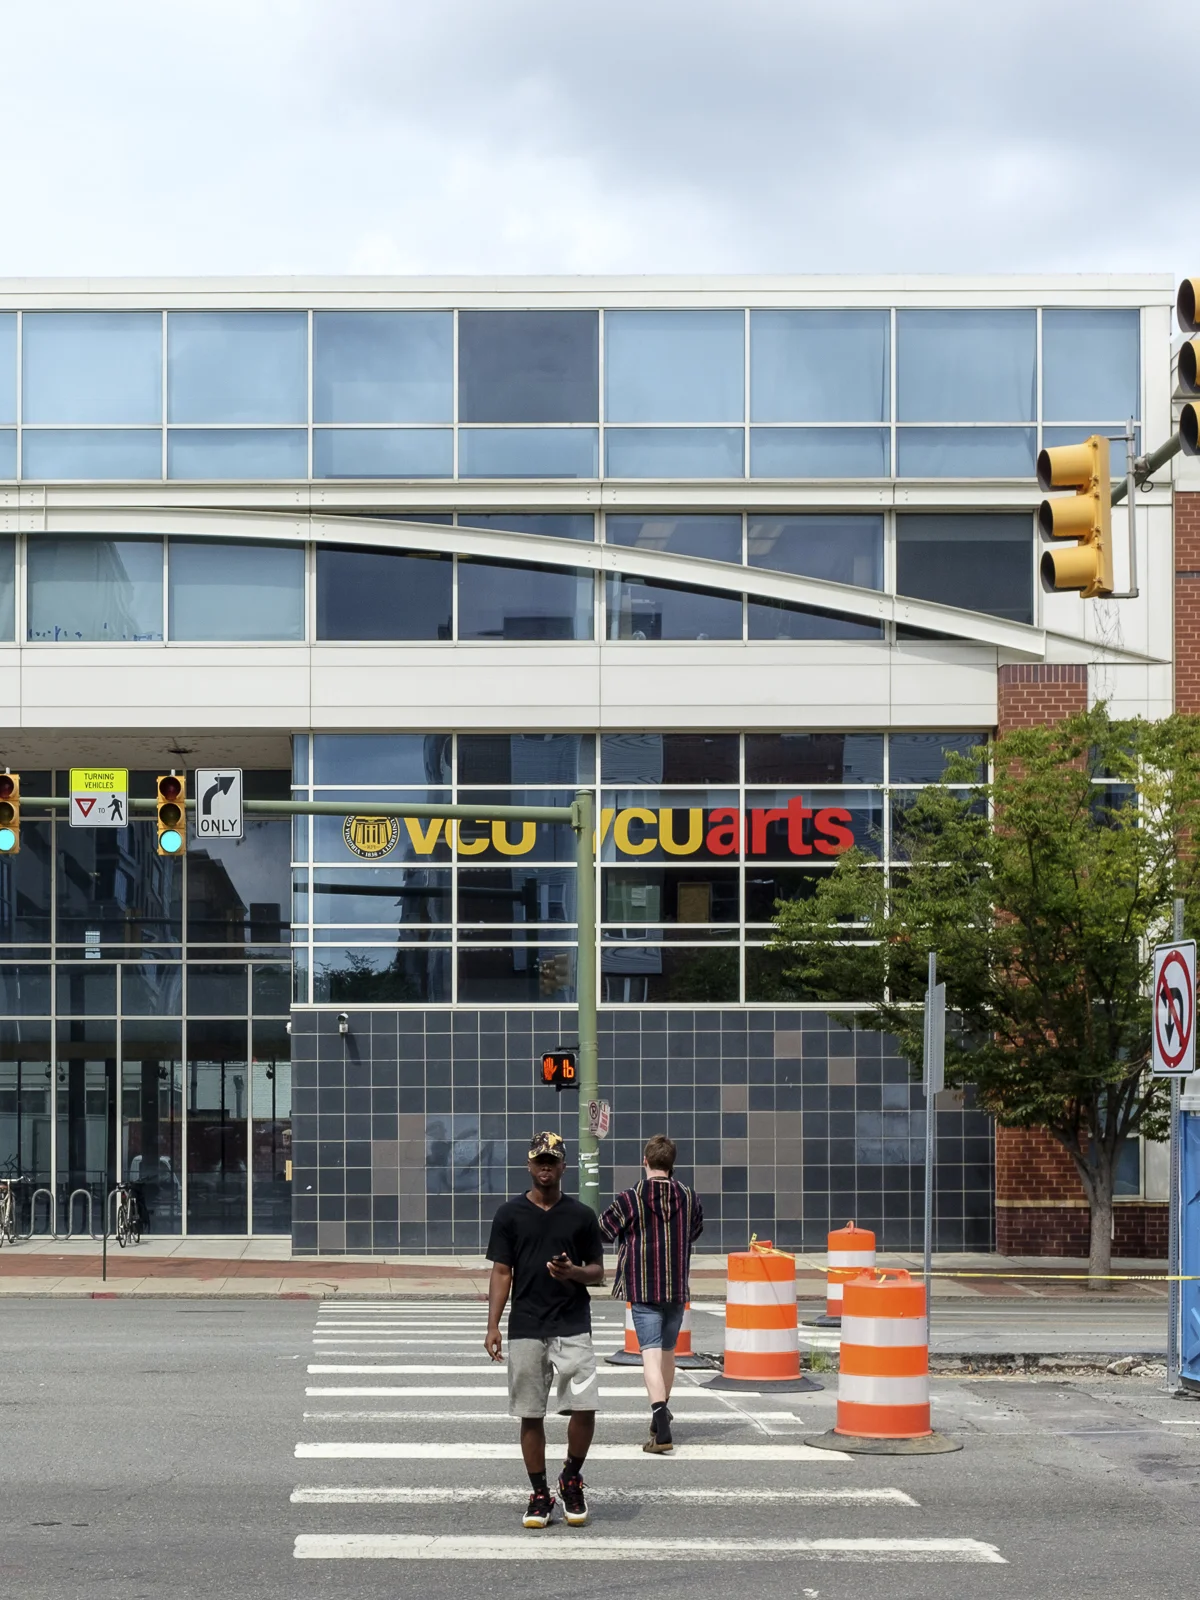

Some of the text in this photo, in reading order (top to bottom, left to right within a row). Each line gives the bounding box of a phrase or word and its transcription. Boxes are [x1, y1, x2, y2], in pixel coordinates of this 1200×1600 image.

[83, 772, 115, 781] TURNING
[84, 781, 114, 789] VEHICLES
[200, 819, 238, 832] ONLY
[403, 816, 537, 856] vcu
